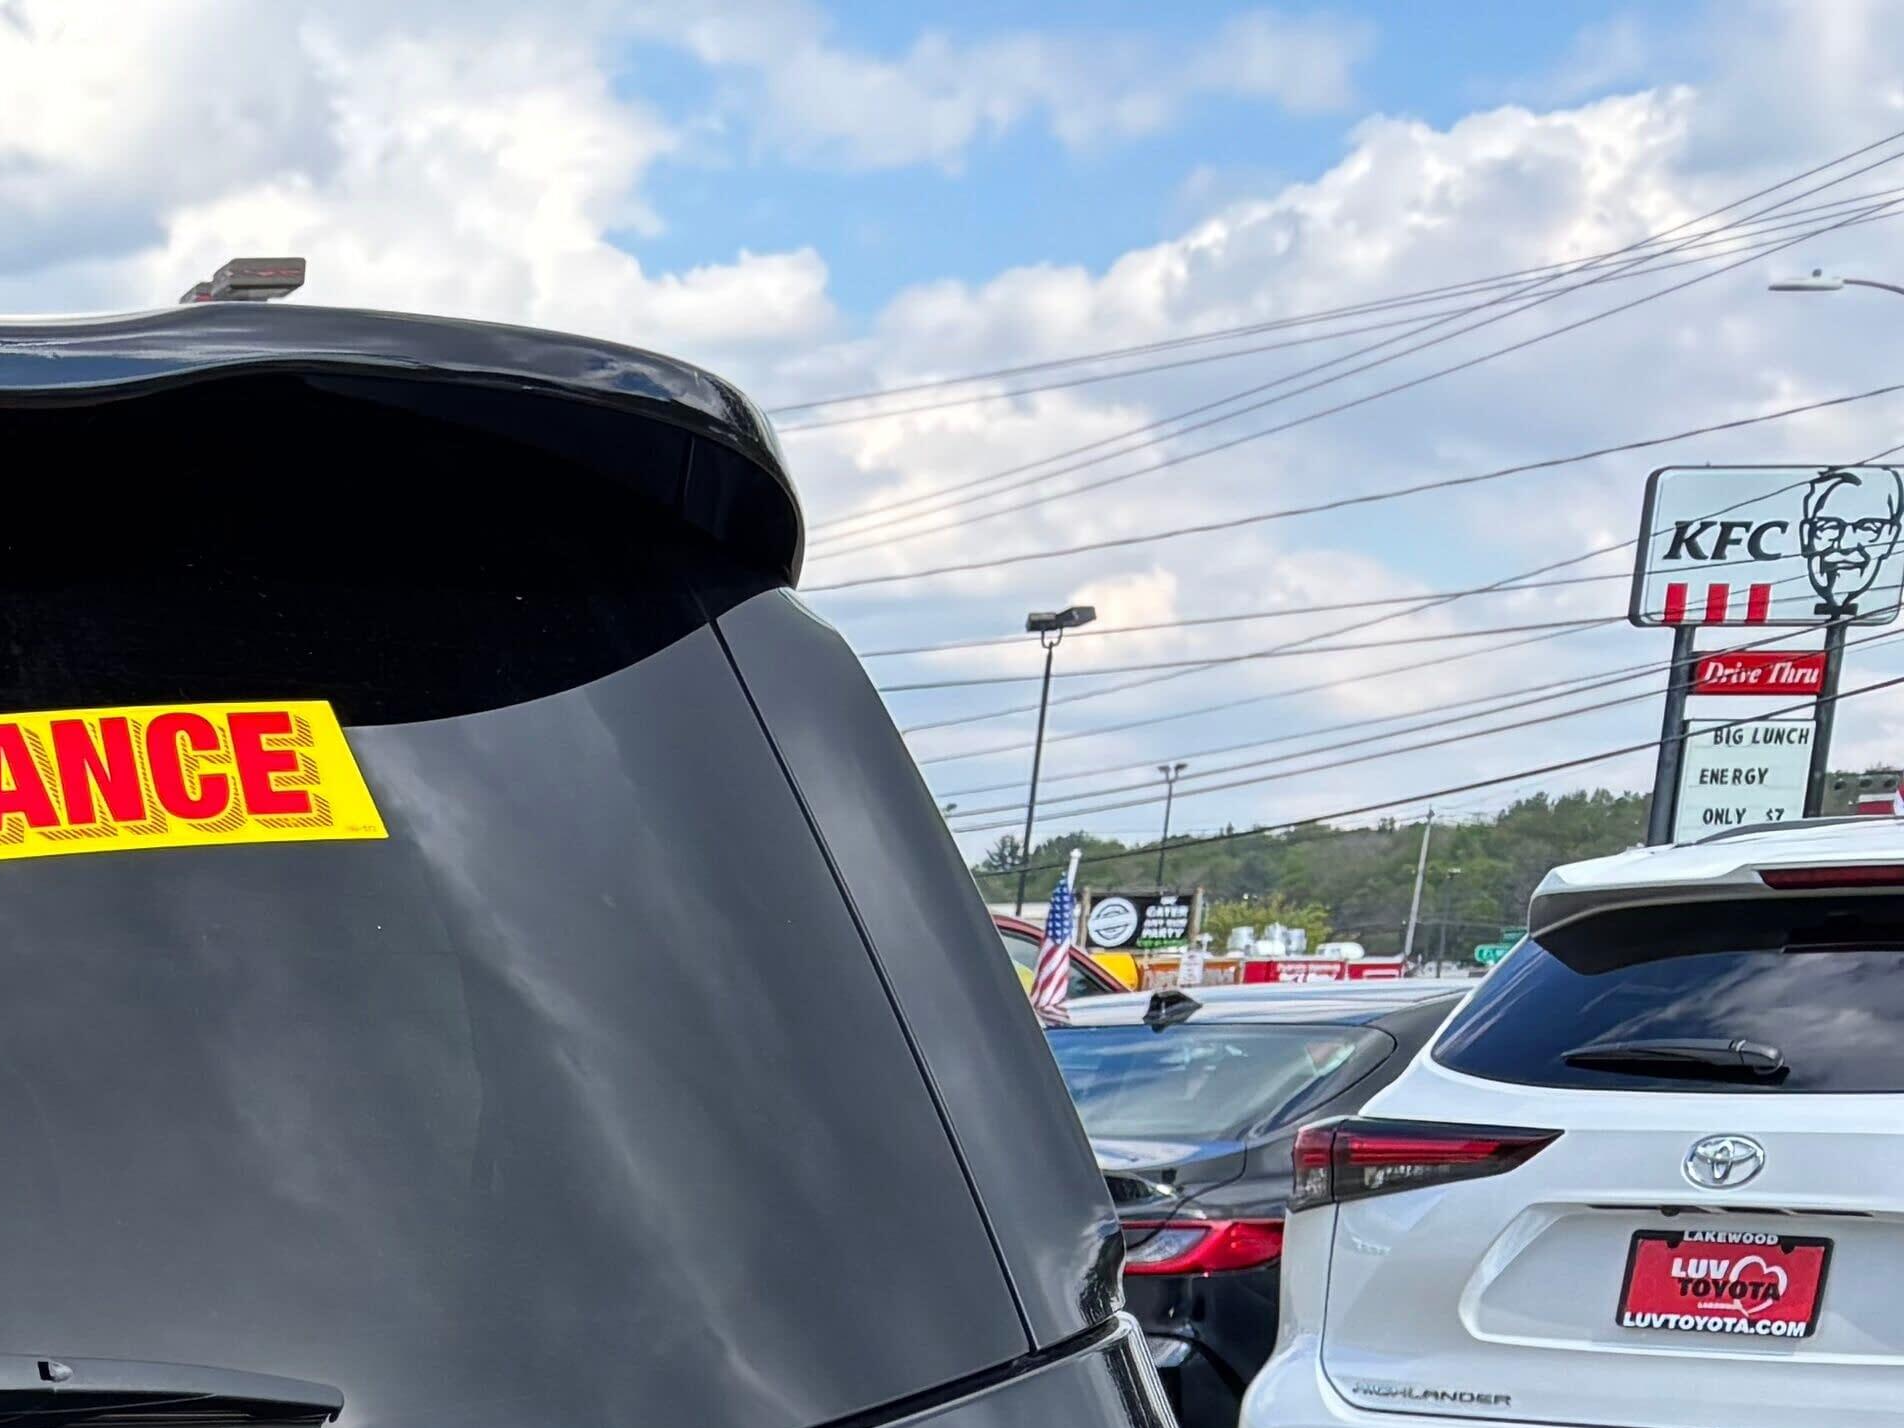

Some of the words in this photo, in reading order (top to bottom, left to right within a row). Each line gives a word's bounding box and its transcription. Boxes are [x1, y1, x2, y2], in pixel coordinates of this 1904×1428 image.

[1662, 520, 1789, 562] KFC
[1703, 661, 1763, 684] Drive
[1766, 660, 1820, 684] Thru
[1713, 727, 1744, 745] BIG
[1751, 728, 1810, 745] LUNCH
[1699, 768, 1769, 785] ENERGY
[1702, 808, 1746, 825] ONLY
[1683, 1230, 1779, 1246] LAKEWOOD
[1671, 1257, 1730, 1279] LUV
[1678, 1278, 1782, 1301] TOYOTA
[1622, 1311, 1807, 1338] LUVTOYOTA.COM
